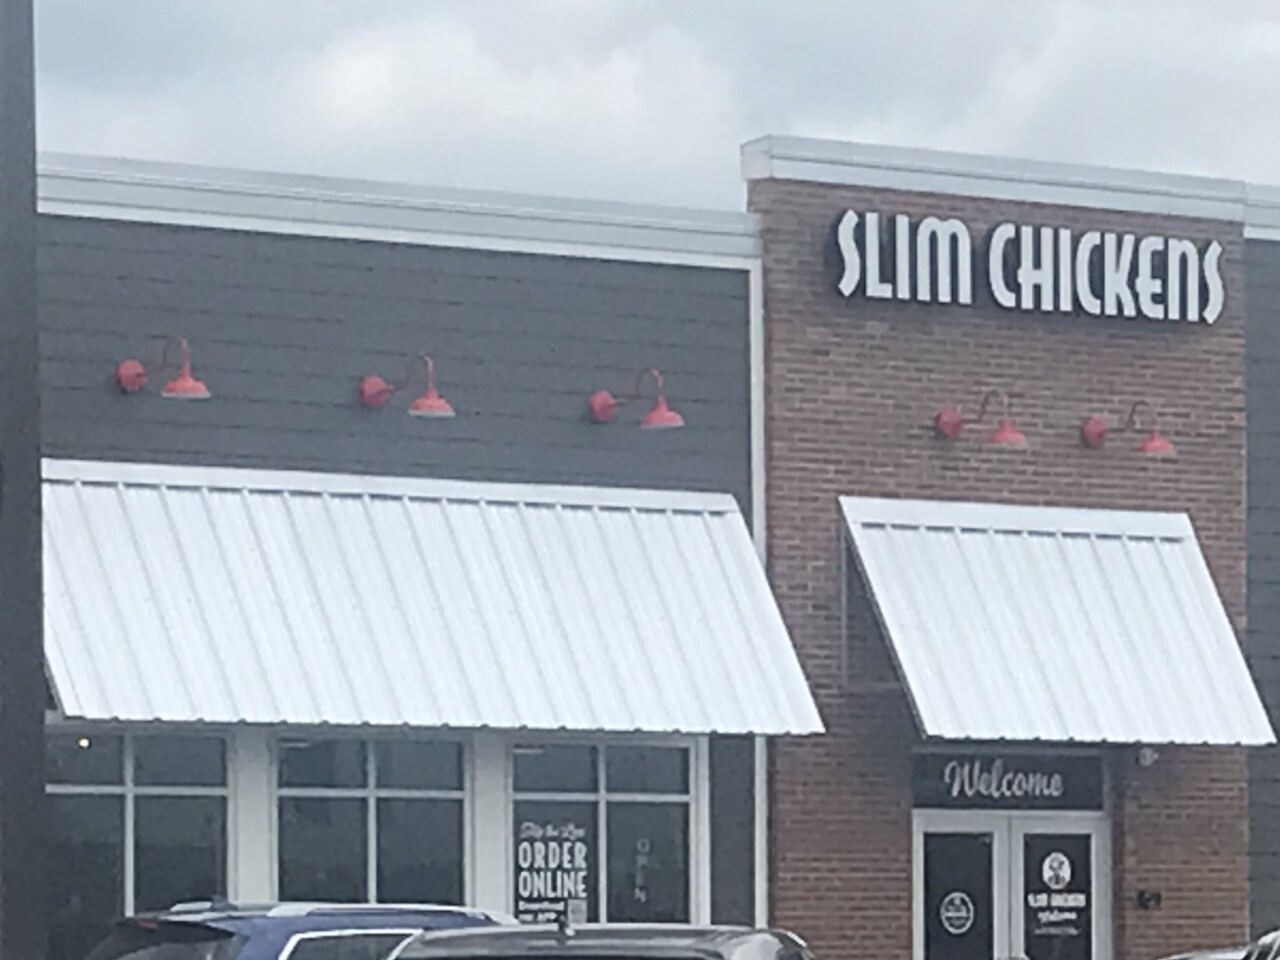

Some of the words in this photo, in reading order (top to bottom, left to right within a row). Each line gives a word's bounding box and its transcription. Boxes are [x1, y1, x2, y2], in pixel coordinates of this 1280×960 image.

[837, 209, 973, 306] SLIM
[988, 222, 1225, 324] CHICKENS
[943, 758, 1064, 799] Welcome
[518, 841, 588, 869] ORDER
[518, 870, 588, 899] ONLINE
